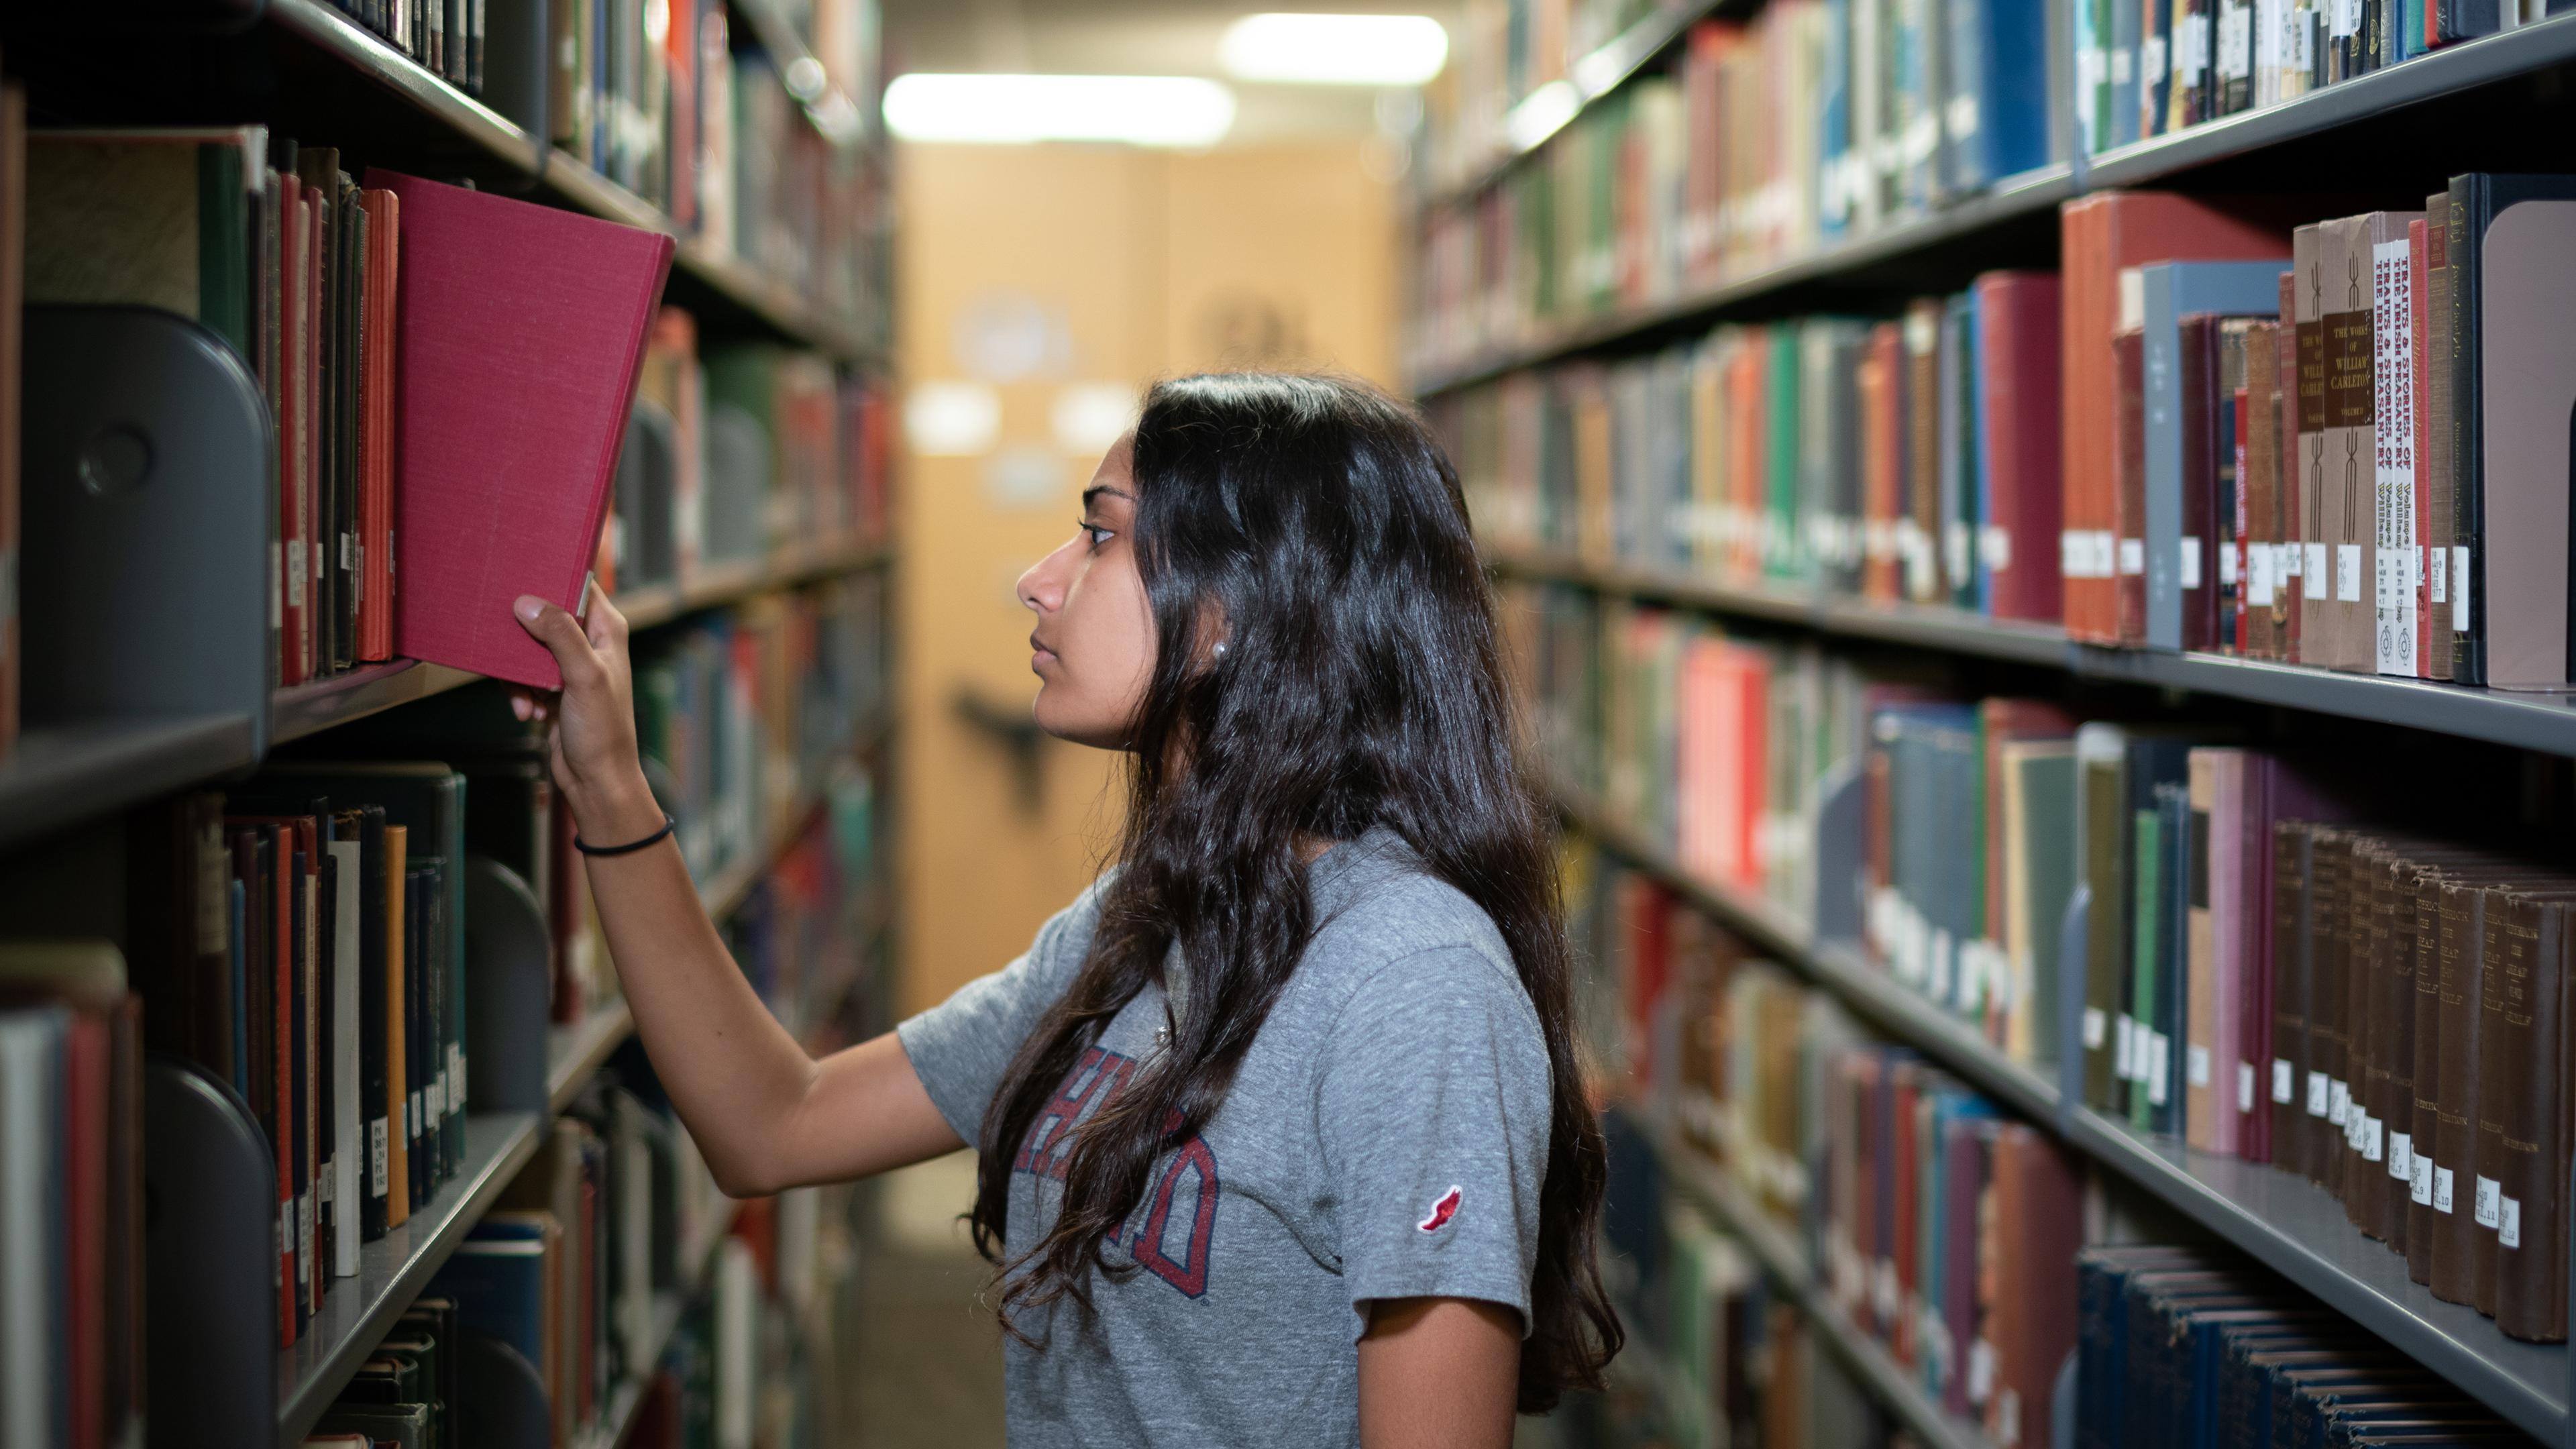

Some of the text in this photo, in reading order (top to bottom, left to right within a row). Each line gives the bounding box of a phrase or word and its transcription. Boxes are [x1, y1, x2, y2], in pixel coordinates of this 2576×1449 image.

[2334, 327, 2348, 339] THE
[2350, 325, 2368, 336] WORKS
[2349, 342, 2357, 353] OF
[2384, 338, 2391, 350] &
[2402, 337, 2409, 348] &
[2336, 356, 2368, 370] WILLIAM
[2303, 365, 2323, 379] WILL
[2330, 374, 2369, 390] CARLETON
[2300, 382, 2323, 397] CARLE
[2341, 407, 2358, 417] VOLUME
[2377, 362, 2385, 470] PEASANTRY
[2385, 447, 2392, 470] OF
[2404, 447, 2410, 470] OF
